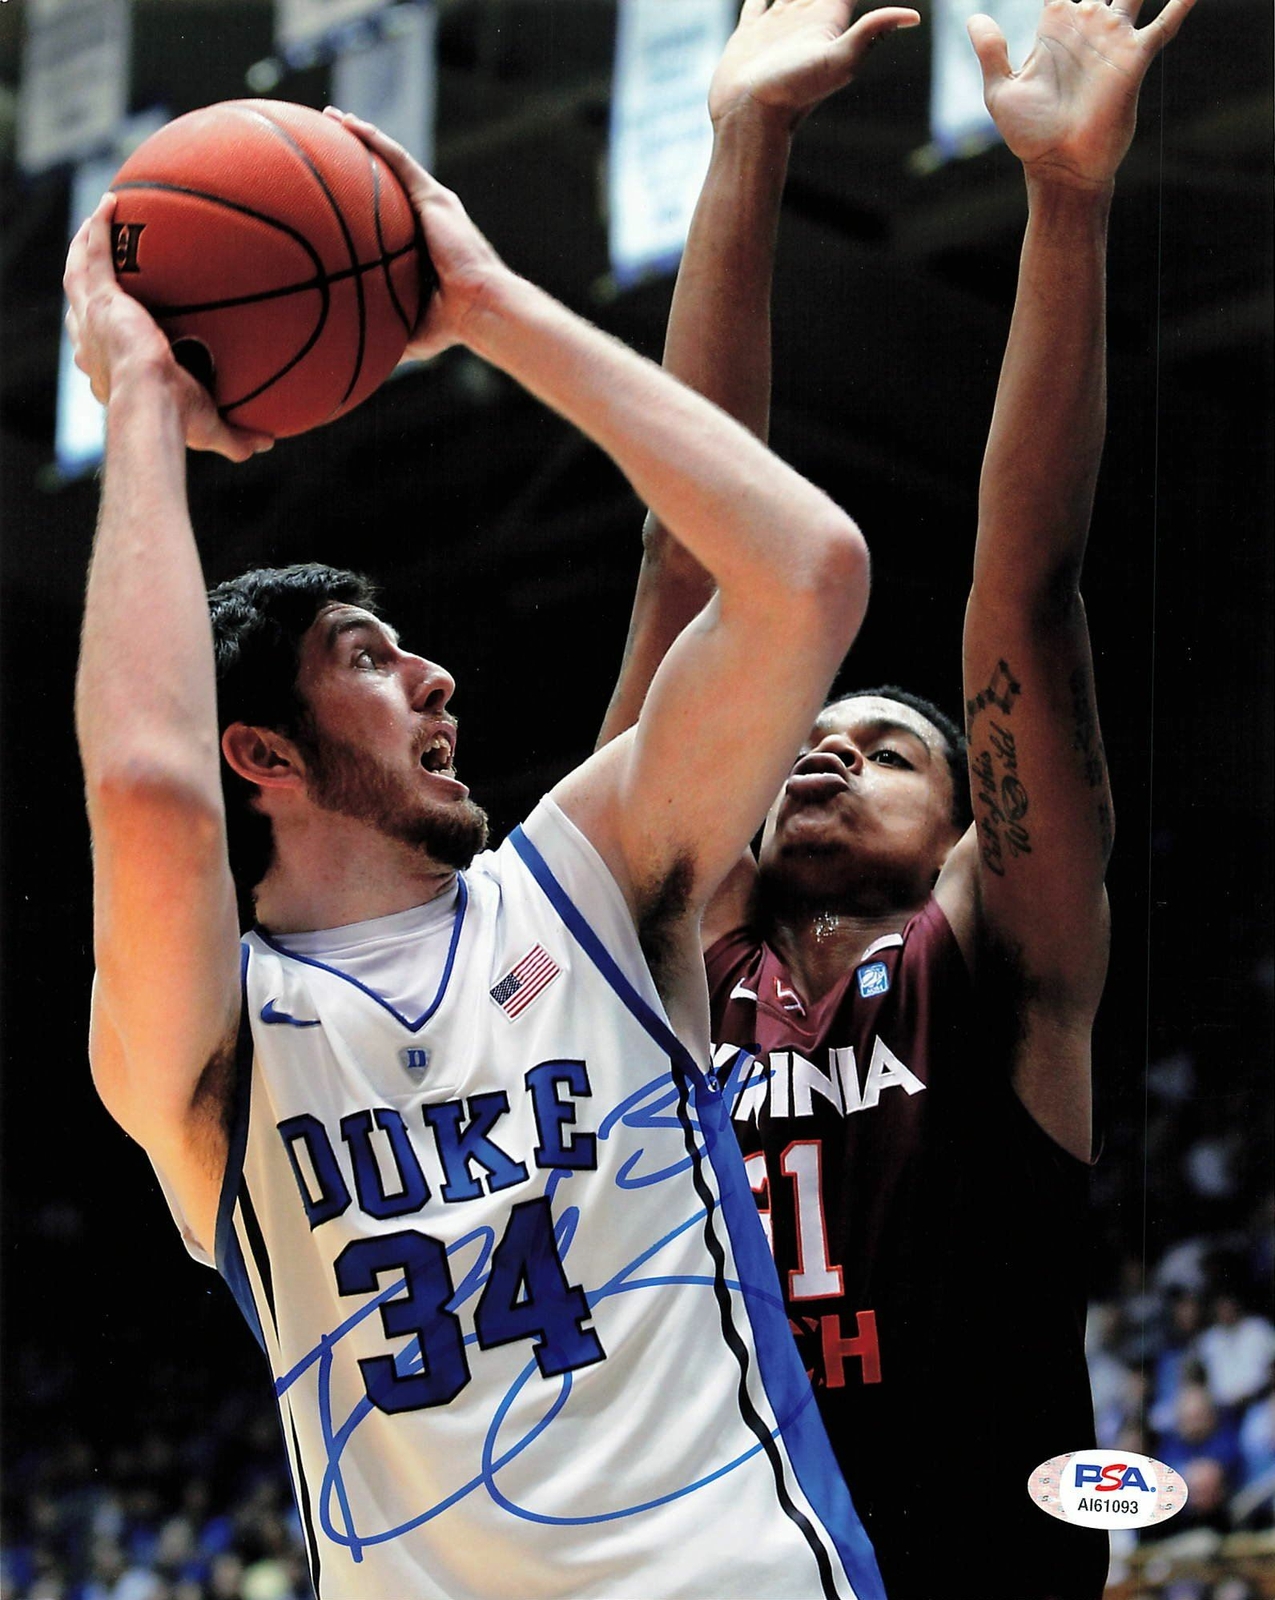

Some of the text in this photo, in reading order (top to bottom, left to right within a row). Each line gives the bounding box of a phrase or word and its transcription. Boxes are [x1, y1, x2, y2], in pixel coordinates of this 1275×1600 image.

[407, 1049, 427, 1068] D
[276, 1059, 598, 1232] DUKE
[333, 1195, 608, 1416] 34
